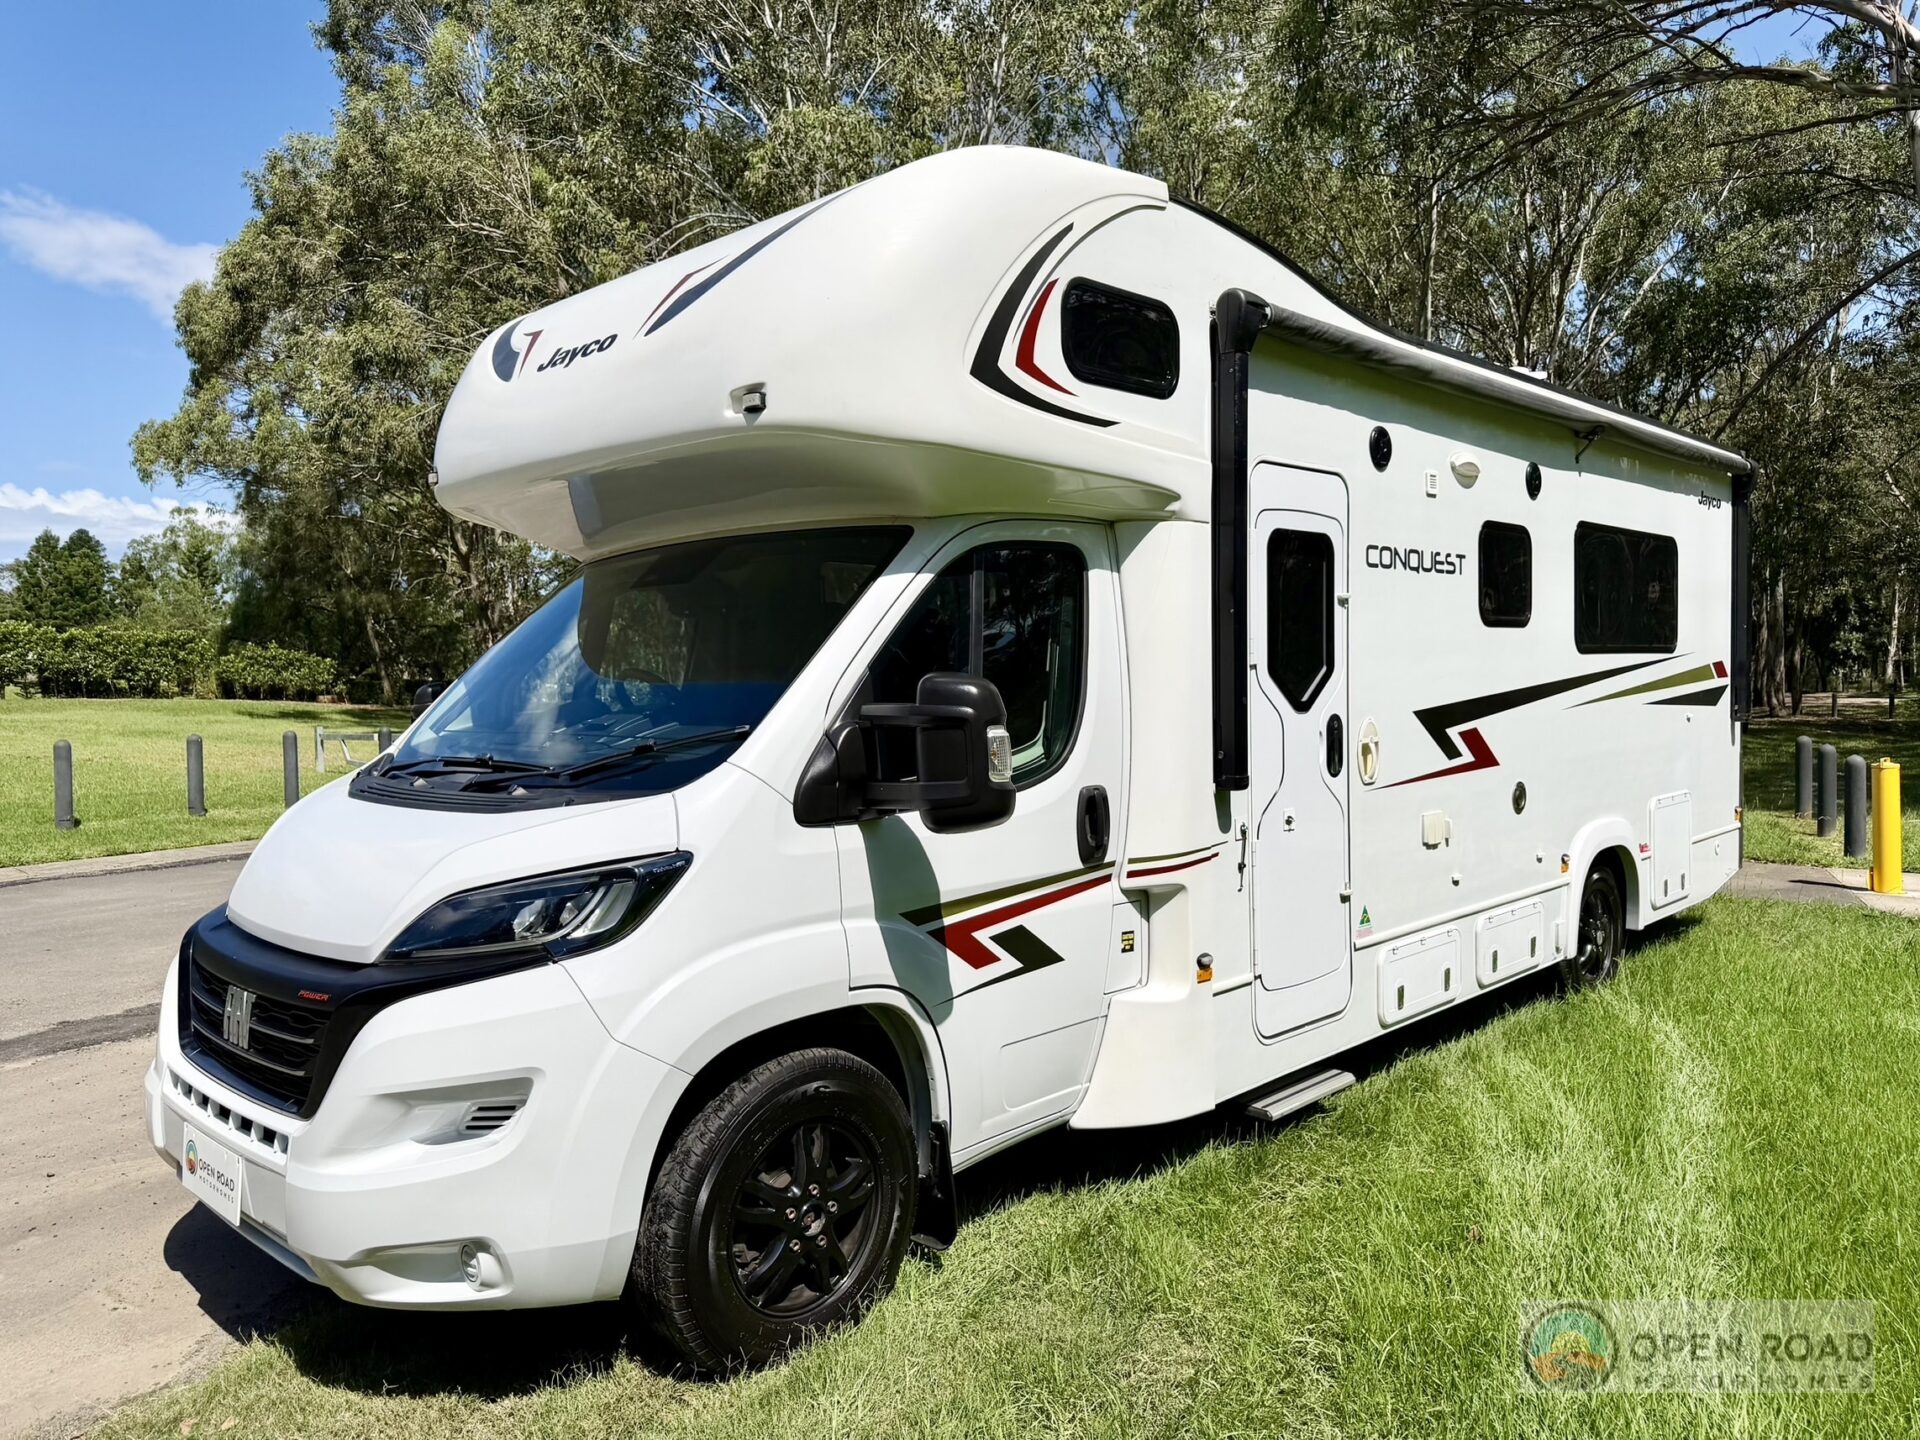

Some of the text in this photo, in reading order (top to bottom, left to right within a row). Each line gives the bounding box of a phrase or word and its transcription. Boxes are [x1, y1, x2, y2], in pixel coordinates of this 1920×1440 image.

[536, 333, 618, 372] Jayco
[1698, 490, 1721, 511] Jayco
[1365, 544, 1466, 575] CONQUEST
[298, 990, 331, 1001] POWER
[223, 984, 257, 1050] FIAT
[198, 1158, 235, 1192] OPEN ROAD
[199, 1174, 234, 1204] MOTORHOMES
